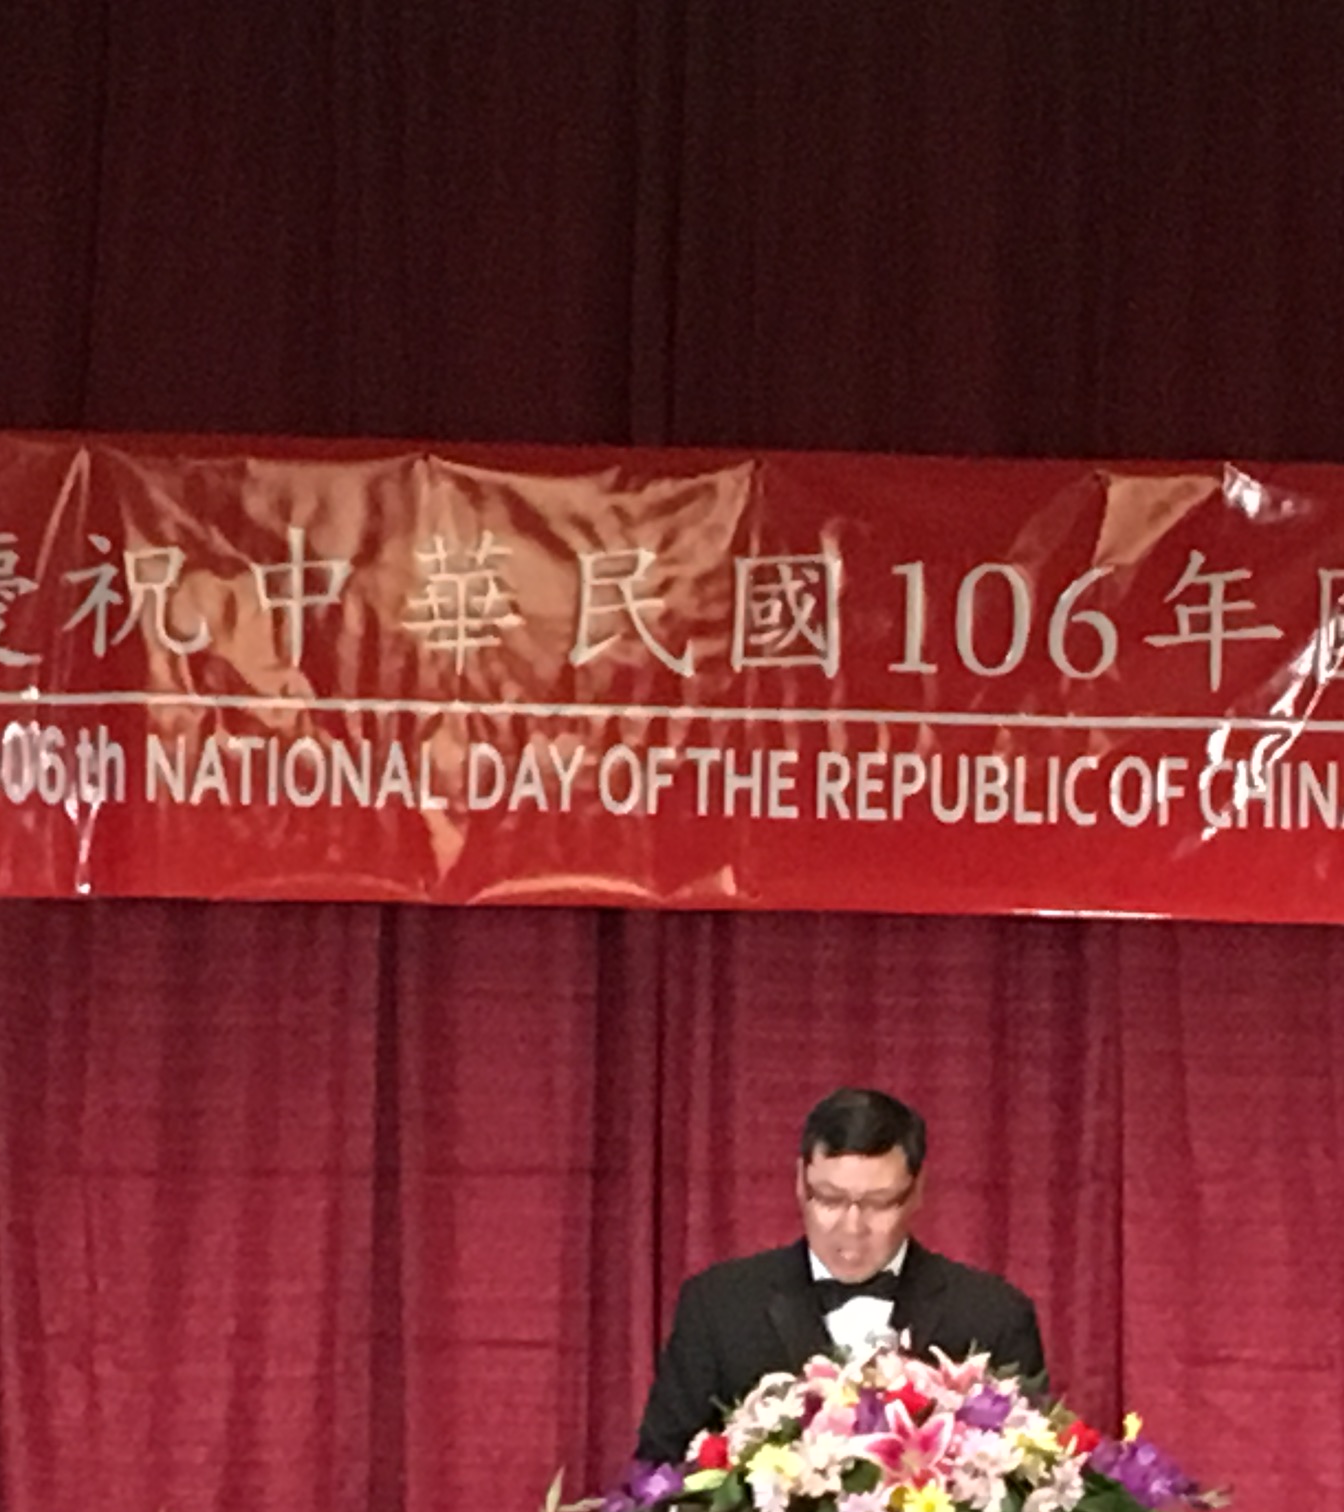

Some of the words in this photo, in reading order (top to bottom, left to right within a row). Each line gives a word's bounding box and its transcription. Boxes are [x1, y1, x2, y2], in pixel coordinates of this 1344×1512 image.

[146, 735, 446, 812] NATIONAL
[468, 743, 578, 815] DAY
[599, 747, 688, 816] OF
[686, 748, 795, 820] THE
[816, 756, 1098, 828] REPUBLIC
[1108, 755, 1188, 828] OF
